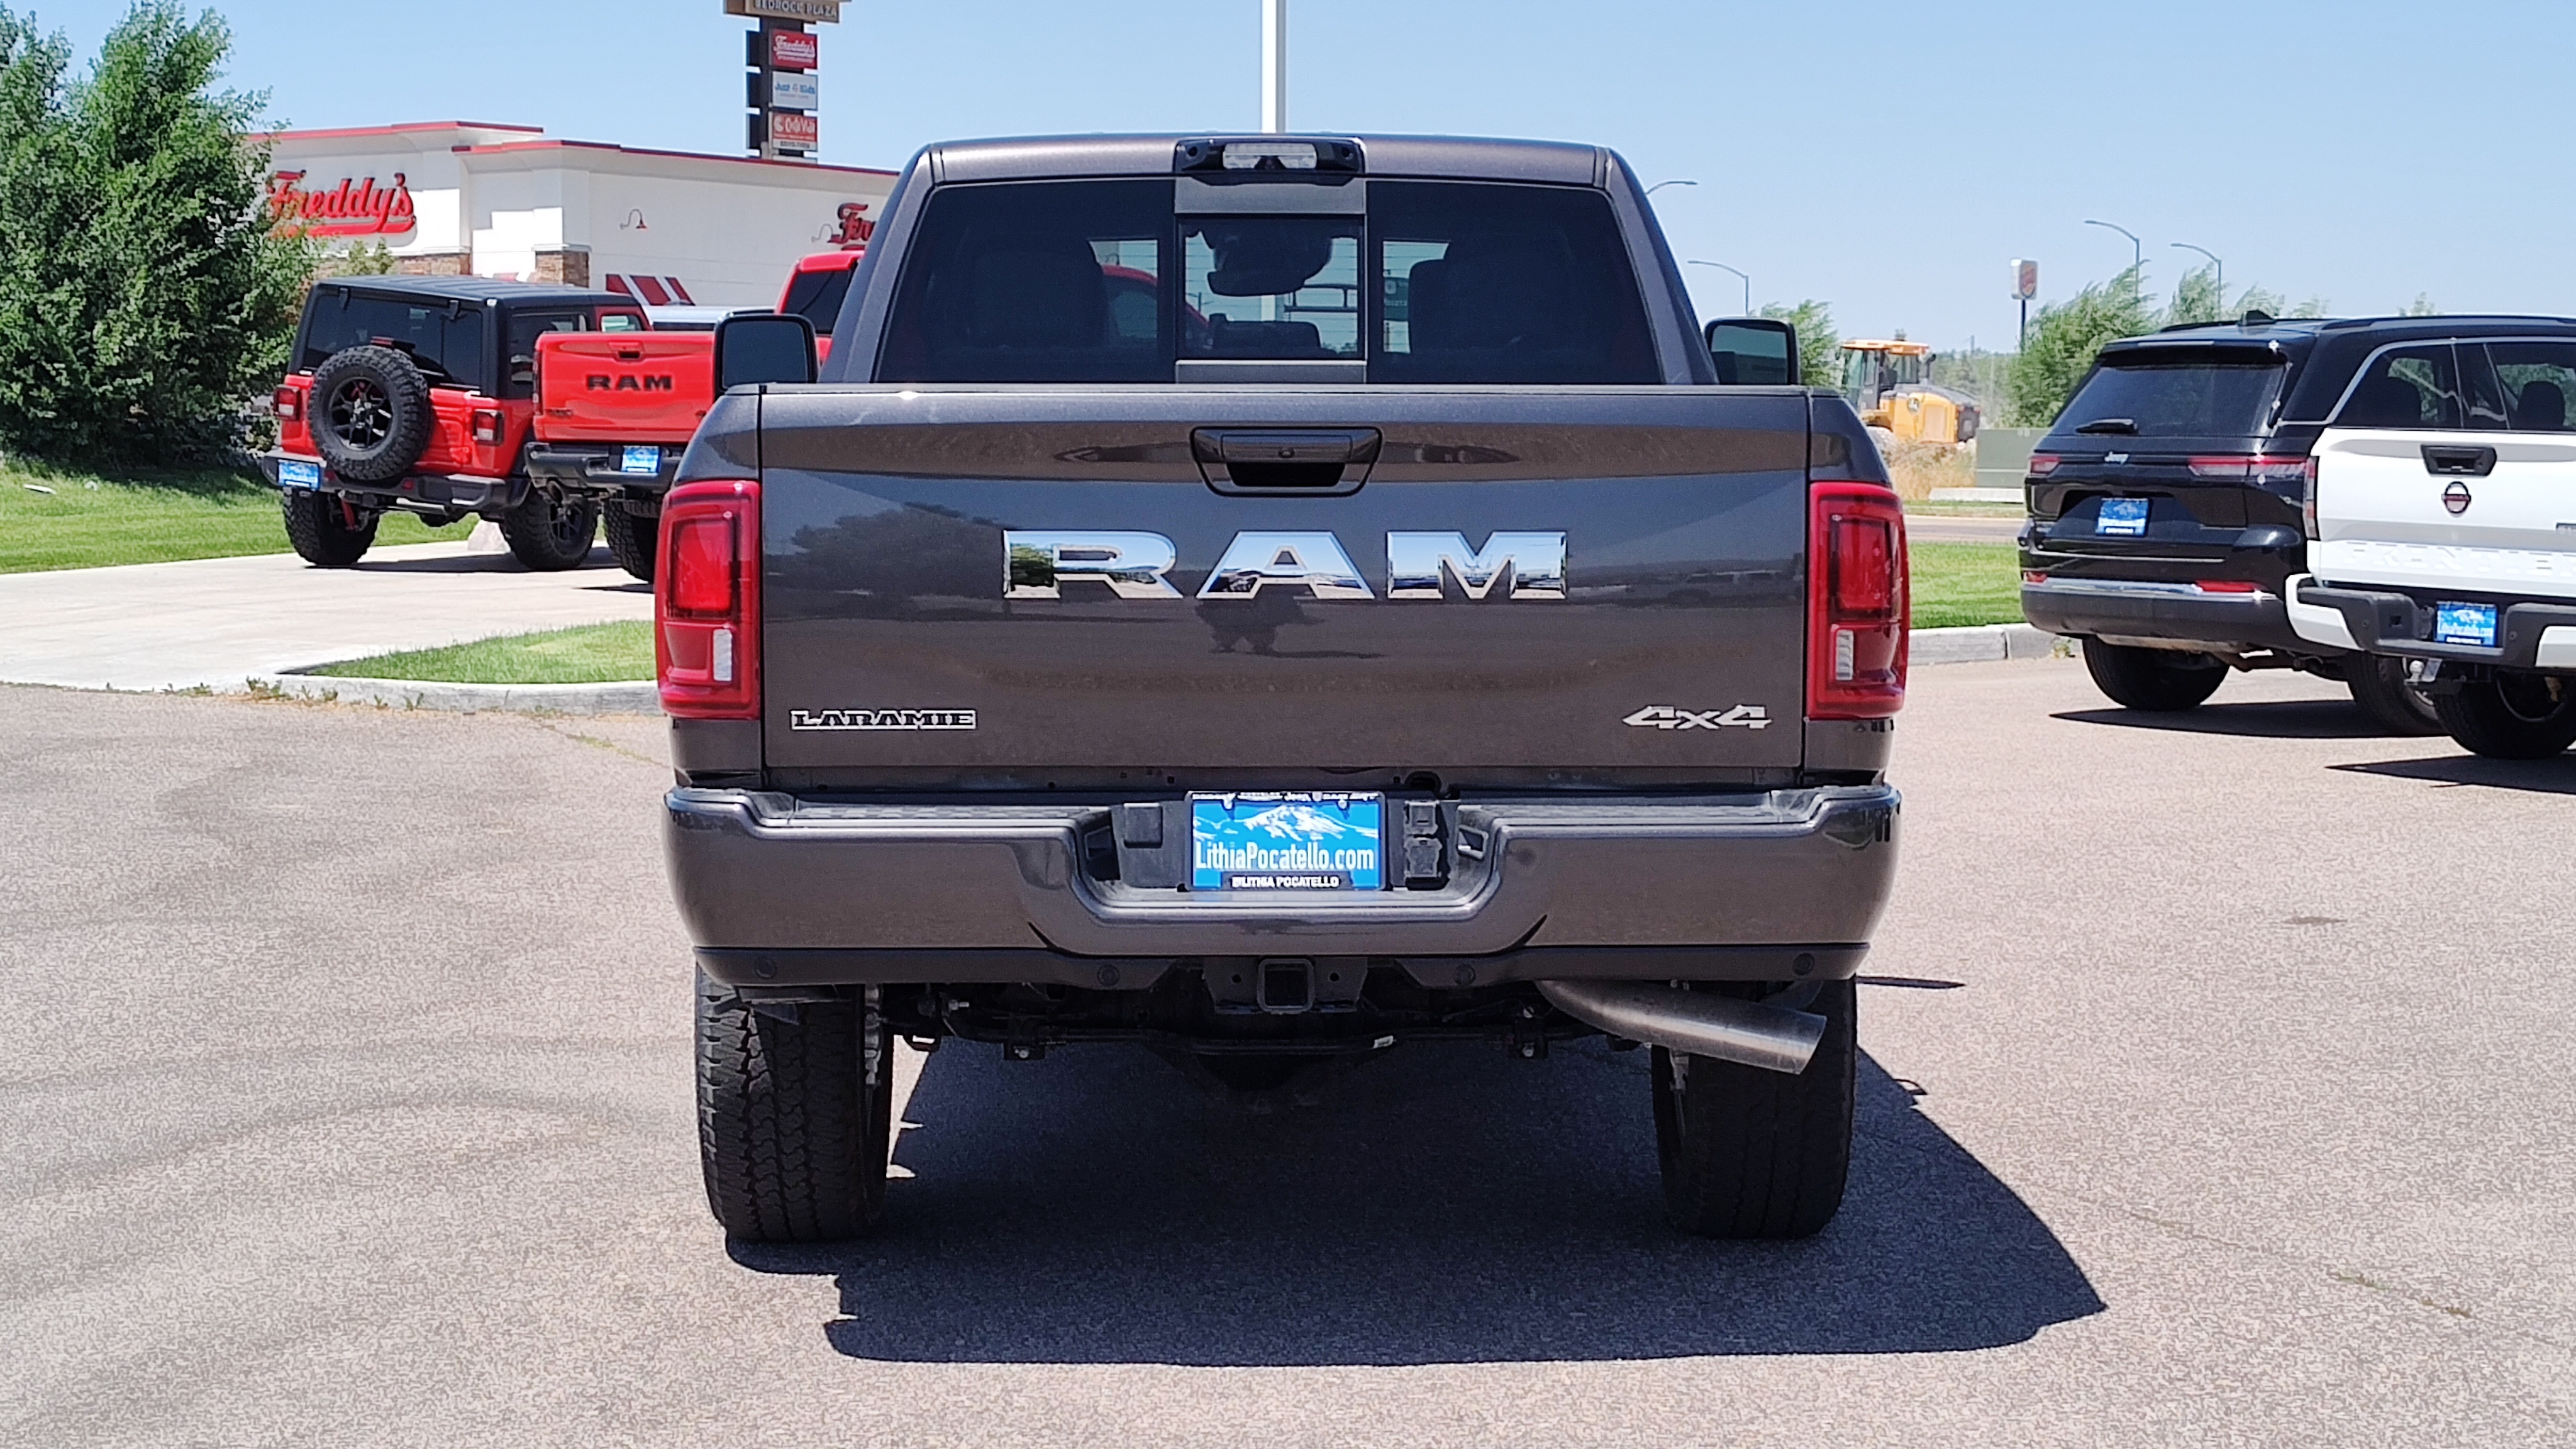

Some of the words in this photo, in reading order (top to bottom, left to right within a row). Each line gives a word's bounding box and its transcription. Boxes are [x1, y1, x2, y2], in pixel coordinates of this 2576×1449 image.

[806, 3, 838, 18] PLAZA
[774, 35, 815, 58] Freddy's
[267, 170, 416, 235] Freddy's
[586, 374, 672, 391] RAM
[1003, 529, 1568, 599] RAM
[790, 709, 976, 730] LARAMIE
[1622, 704, 1772, 730] 4x4
[1195, 841, 1374, 869] LithiaPocatello.com
[1276, 876, 1340, 887] POCATELLO
